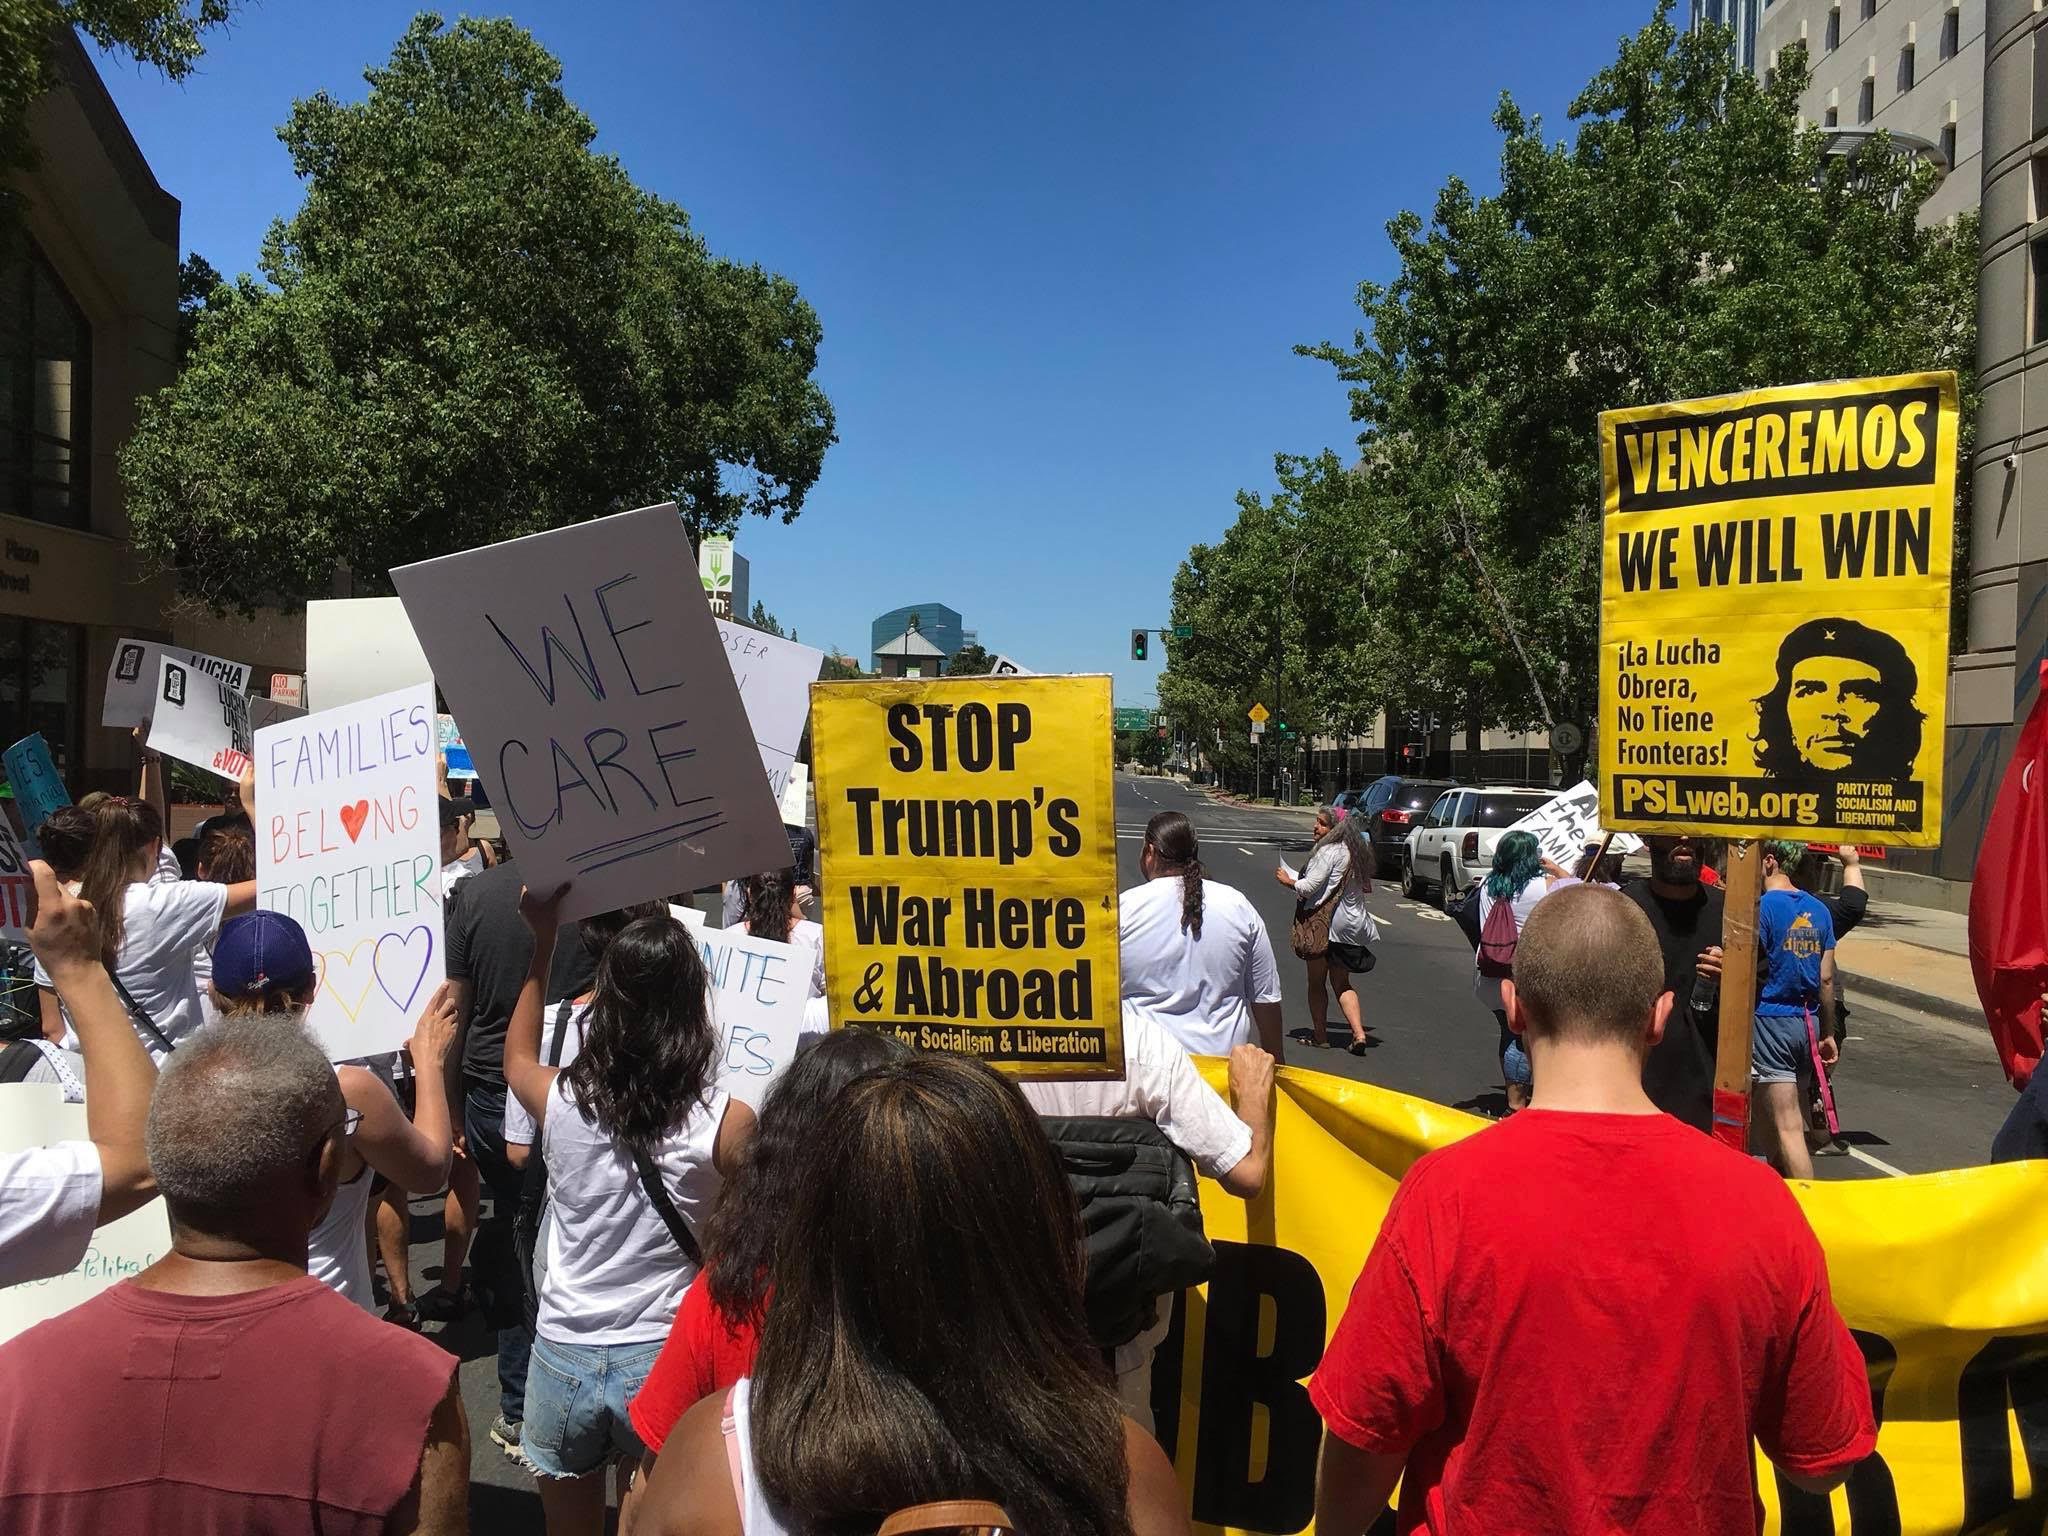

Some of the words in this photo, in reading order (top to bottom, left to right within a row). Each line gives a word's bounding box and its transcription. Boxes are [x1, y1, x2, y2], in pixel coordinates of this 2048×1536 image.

[1624, 401, 1927, 494] VENCEREMOS
[1619, 528, 1678, 593] WE
[1694, 517, 1803, 587] WILL
[1821, 508, 1930, 579] WIN
[485, 573, 685, 707] WE
[1655, 638, 1720, 666] Lucha
[273, 676, 288, 688] NO
[1618, 673, 1697, 702] Obrera,
[887, 702, 1031, 773] STOP
[1618, 706, 1644, 732] No
[1652, 706, 1713, 732] Tiene
[272, 705, 430, 788] FAMILIES
[1618, 739, 1728, 766] Fronteras!
[499, 720, 715, 840] CARE
[1621, 779, 1819, 824] PSLweb.org
[1836, 782, 1870, 796] PARTY
[1871, 783, 1893, 797] FOR
[1836, 797, 1892, 811] SOCIALISM
[1894, 800, 1916, 812] AND
[1836, 811, 1895, 825] LIBERATION
[262, 854, 439, 933] TOGETHER
[850, 886, 951, 947] War
[964, 888, 1086, 949] Here
[697, 941, 787, 1006] NITE
[853, 961, 884, 1014] &
[895, 956, 1092, 1020] Abroad
[921, 1025, 994, 1053] Socialism
[1000, 1029, 1012, 1052] &
[1018, 1030, 1100, 1054] Liberation
